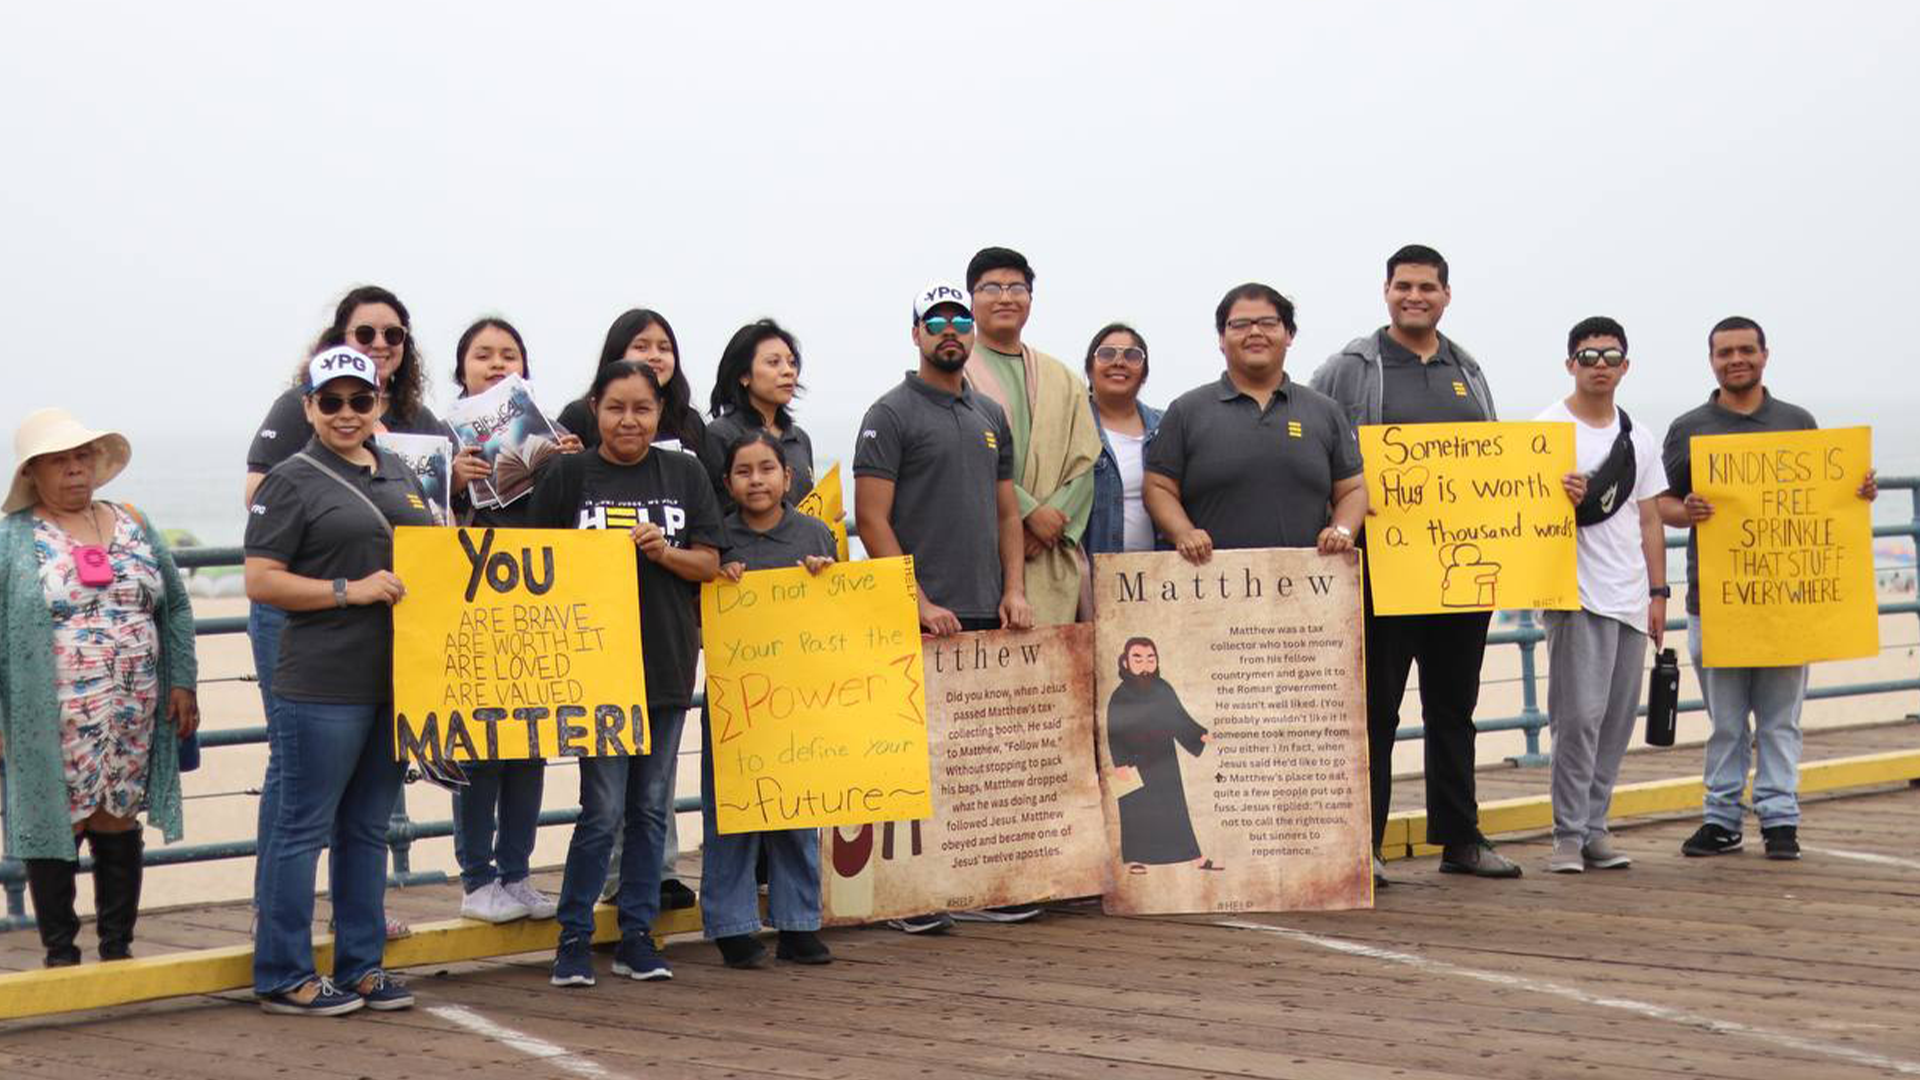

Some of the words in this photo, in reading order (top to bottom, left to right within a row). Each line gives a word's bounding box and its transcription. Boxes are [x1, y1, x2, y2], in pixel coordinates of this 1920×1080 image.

[320, 354, 366, 372] YPG
[1383, 426, 1503, 465] Sometimes
[1531, 434, 1551, 454] a
[1709, 450, 1811, 485] KINDNESS
[1823, 447, 1844, 481] IS
[1382, 473, 1423, 507] Hug
[1437, 475, 1457, 503] is
[1472, 473, 1551, 499] worth
[1762, 488, 1817, 516] FREE
[1386, 526, 1409, 546] a
[1427, 512, 1522, 545] thousand
[1534, 516, 1575, 539] words
[1741, 518, 1836, 547] SPRINKLE
[457, 528, 555, 603] YOU
[1729, 549, 1784, 577] THAT
[1789, 546, 1846, 576] STUFF
[716, 584, 758, 614] Do
[771, 582, 807, 601] not
[828, 572, 877, 597] give
[1116, 567, 1335, 602] Matthew
[1722, 578, 1842, 605] EVERYWHERE
[460, 607, 506, 633] ARE
[513, 604, 591, 633] BRAVE
[444, 633, 487, 655] ARE
[492, 631, 569, 655] WORTH
[573, 628, 605, 652] IT
[866, 626, 903, 646] the
[1230, 626, 1276, 636] Matthew
[1278, 626, 1297, 634] was
[1308, 625, 1323, 633] tax
[935, 638, 1041, 673] tthew
[1211, 640, 1256, 651] collector
[1259, 640, 1280, 650] who
[1283, 639, 1306, 649] took
[1308, 639, 1343, 649] money
[444, 654, 487, 680] ARE
[494, 654, 571, 680] LOVED
[1239, 655, 1265, 665] from
[1267, 655, 1282, 664] his
[1284, 654, 1316, 663] fellow
[1211, 669, 1274, 681] countrymen
[1276, 669, 1295, 678] and
[1297, 669, 1322, 679] gave
[1324, 668, 1332, 676] it
[1334, 668, 1346, 676] to
[443, 682, 489, 706] ARE
[496, 680, 584, 705] VALUED
[946, 691, 963, 704] Did
[964, 691, 983, 705] you
[1013, 684, 1039, 697] when
[1041, 683, 1067, 695] Jesus
[1217, 686, 1234, 695] the
[1237, 685, 1273, 694] Roman
[953, 708, 986, 722] passed
[988, 703, 1036, 717] Matthew's
[1215, 701, 1230, 710] He
[1232, 701, 1265, 710] wasn't
[1268, 700, 1288, 709] well
[948, 725, 994, 740] collecting
[1027, 721, 1040, 732] He
[1042, 717, 1062, 729] said
[1213, 715, 1260, 726] probably
[1262, 714, 1307, 724] wouldn't
[1309, 713, 1328, 723] like
[396, 704, 645, 761] MATTER!
[1212, 730, 1259, 739] someone
[1262, 729, 1283, 738] took
[1287, 729, 1322, 739] money
[1324, 728, 1350, 736] from
[736, 747, 764, 775] to
[778, 731, 850, 764] define
[947, 748, 958, 759] to
[1217, 745, 1237, 755] you
[1317, 742, 1345, 751] when
[946, 763, 984, 777] Without
[986, 760, 1027, 774] stopping
[1028, 757, 1039, 768] to
[1040, 754, 1062, 769] pack
[1218, 759, 1247, 769] Jesus
[1250, 758, 1270, 768] said
[1299, 757, 1318, 766] like
[1320, 757, 1331, 766] to
[1333, 758, 1346, 768] go
[941, 783, 956, 796] his
[984, 778, 1025, 791] Matthew
[1027, 772, 1068, 787] dropped
[1229, 773, 1283, 783] Matthew's
[1285, 772, 1314, 782] place
[1316, 772, 1327, 781] to
[952, 800, 975, 813] what
[977, 798, 989, 810] he
[991, 797, 1009, 808] was
[1010, 794, 1038, 807] doing
[1039, 790, 1058, 802] and
[1213, 789, 1240, 799] quite
[1251, 787, 1270, 796] few
[1272, 787, 1308, 798] people
[1310, 787, 1328, 796] put
[1330, 787, 1344, 797] up
[1240, 802, 1270, 812] Jesus
[1325, 801, 1353, 810] came
[946, 817, 988, 832] followed
[1021, 810, 1063, 823] Matthew
[1221, 818, 1239, 827] not
[1241, 818, 1252, 827] to
[1254, 817, 1273, 826] call
[1276, 816, 1294, 826] the
[941, 836, 977, 851] obeyed
[979, 834, 997, 846] and
[999, 830, 1036, 844] became
[1037, 828, 1058, 839] one
[1060, 824, 1072, 836] of
[1249, 832, 1267, 841] but
[1269, 831, 1307, 840] sinners
[1309, 831, 1321, 840] to
[983, 851, 1014, 864] twelve
